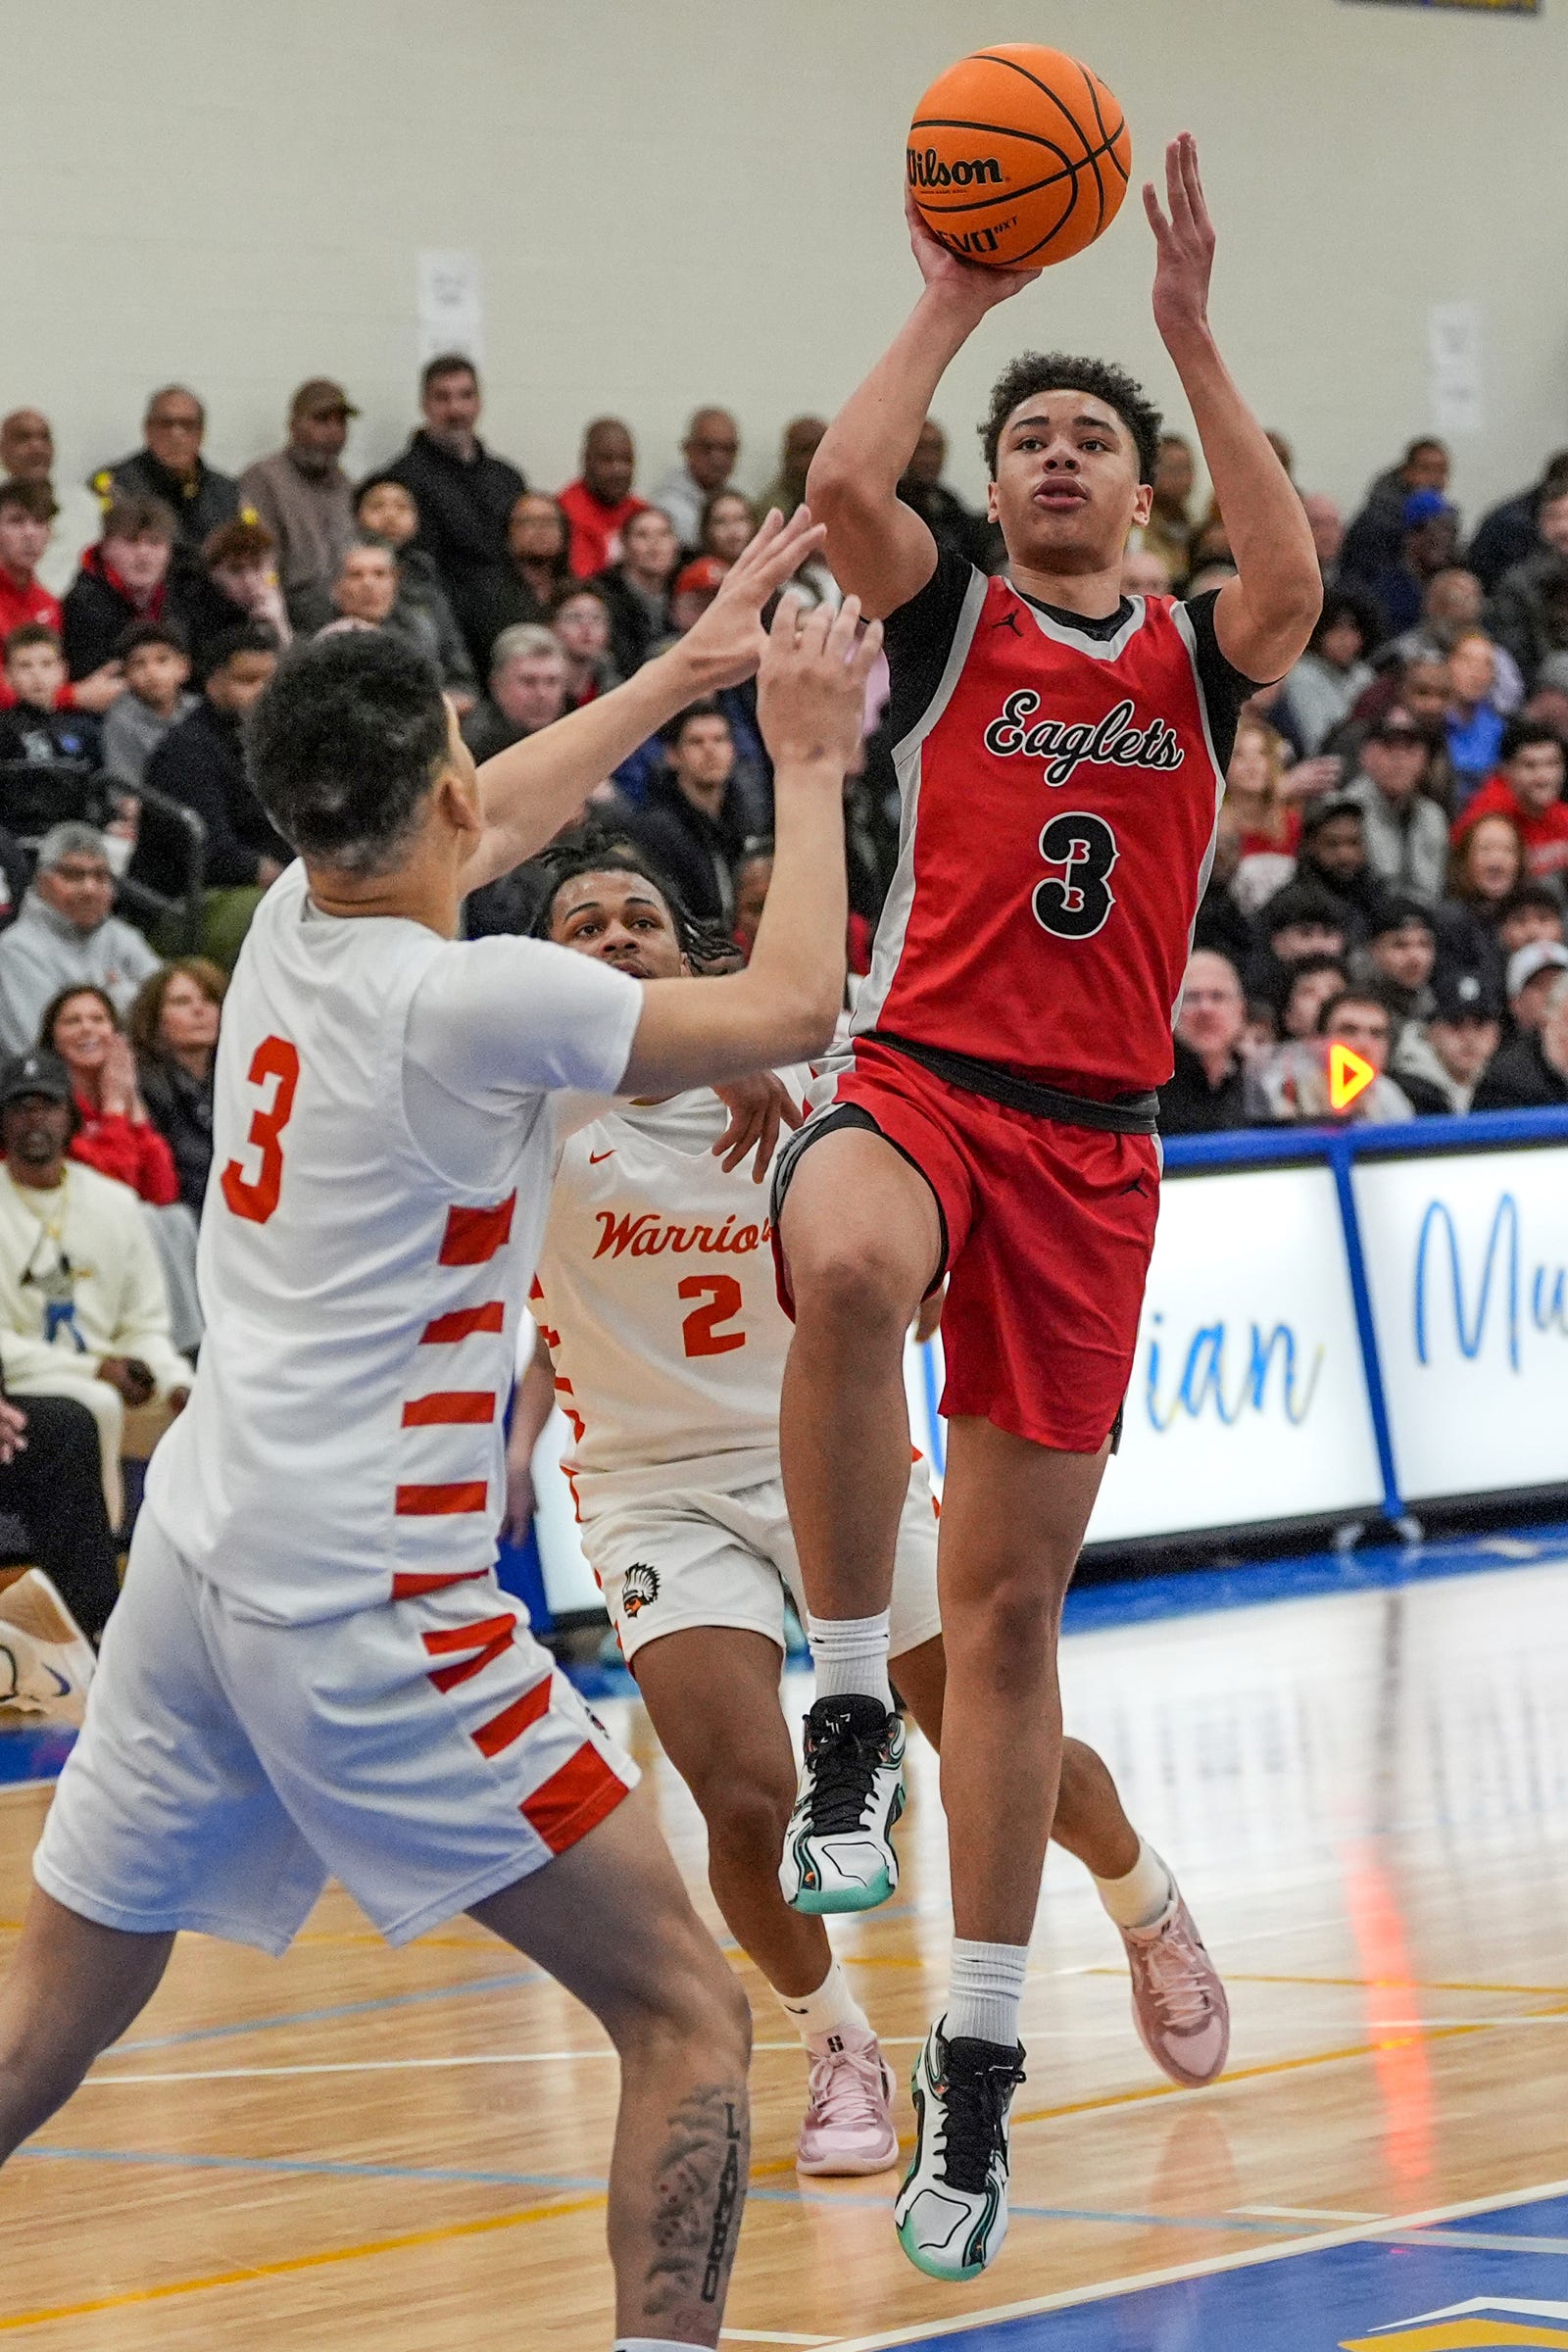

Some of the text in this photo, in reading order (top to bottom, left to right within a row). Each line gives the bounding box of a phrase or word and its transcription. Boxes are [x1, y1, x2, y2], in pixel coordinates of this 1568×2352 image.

[993, 216, 1019, 234] NXT
[984, 689, 1184, 787] Eaglets
[1032, 811, 1120, 940] 3
[220, 1035, 300, 1224] 3
[678, 1275, 746, 1357] 2
[1148, 1313, 1325, 1432] ian
